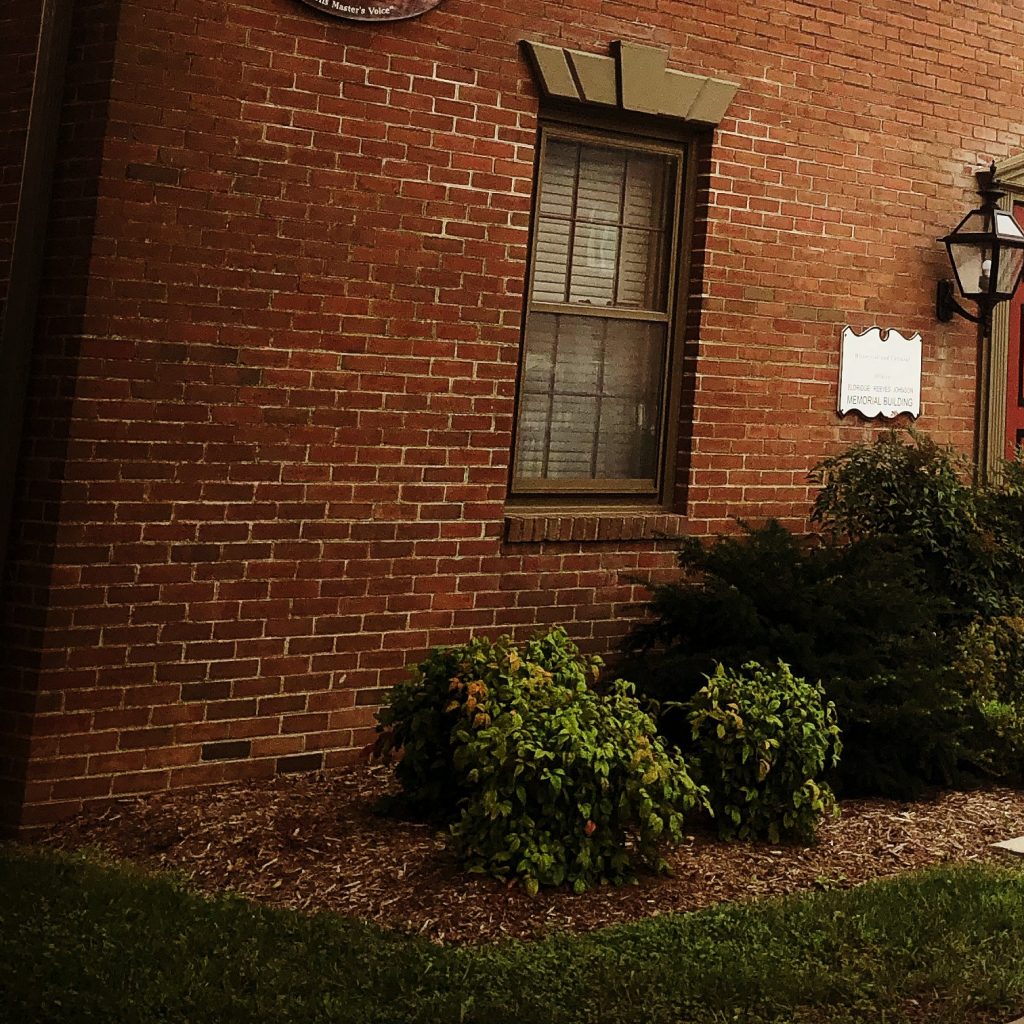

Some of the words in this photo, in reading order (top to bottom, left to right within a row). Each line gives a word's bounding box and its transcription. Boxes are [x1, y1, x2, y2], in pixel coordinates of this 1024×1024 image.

[331, 0, 366, 15] Master's
[847, 395, 881, 406] MEMORIAL
[883, 396, 914, 407] BUILDING
